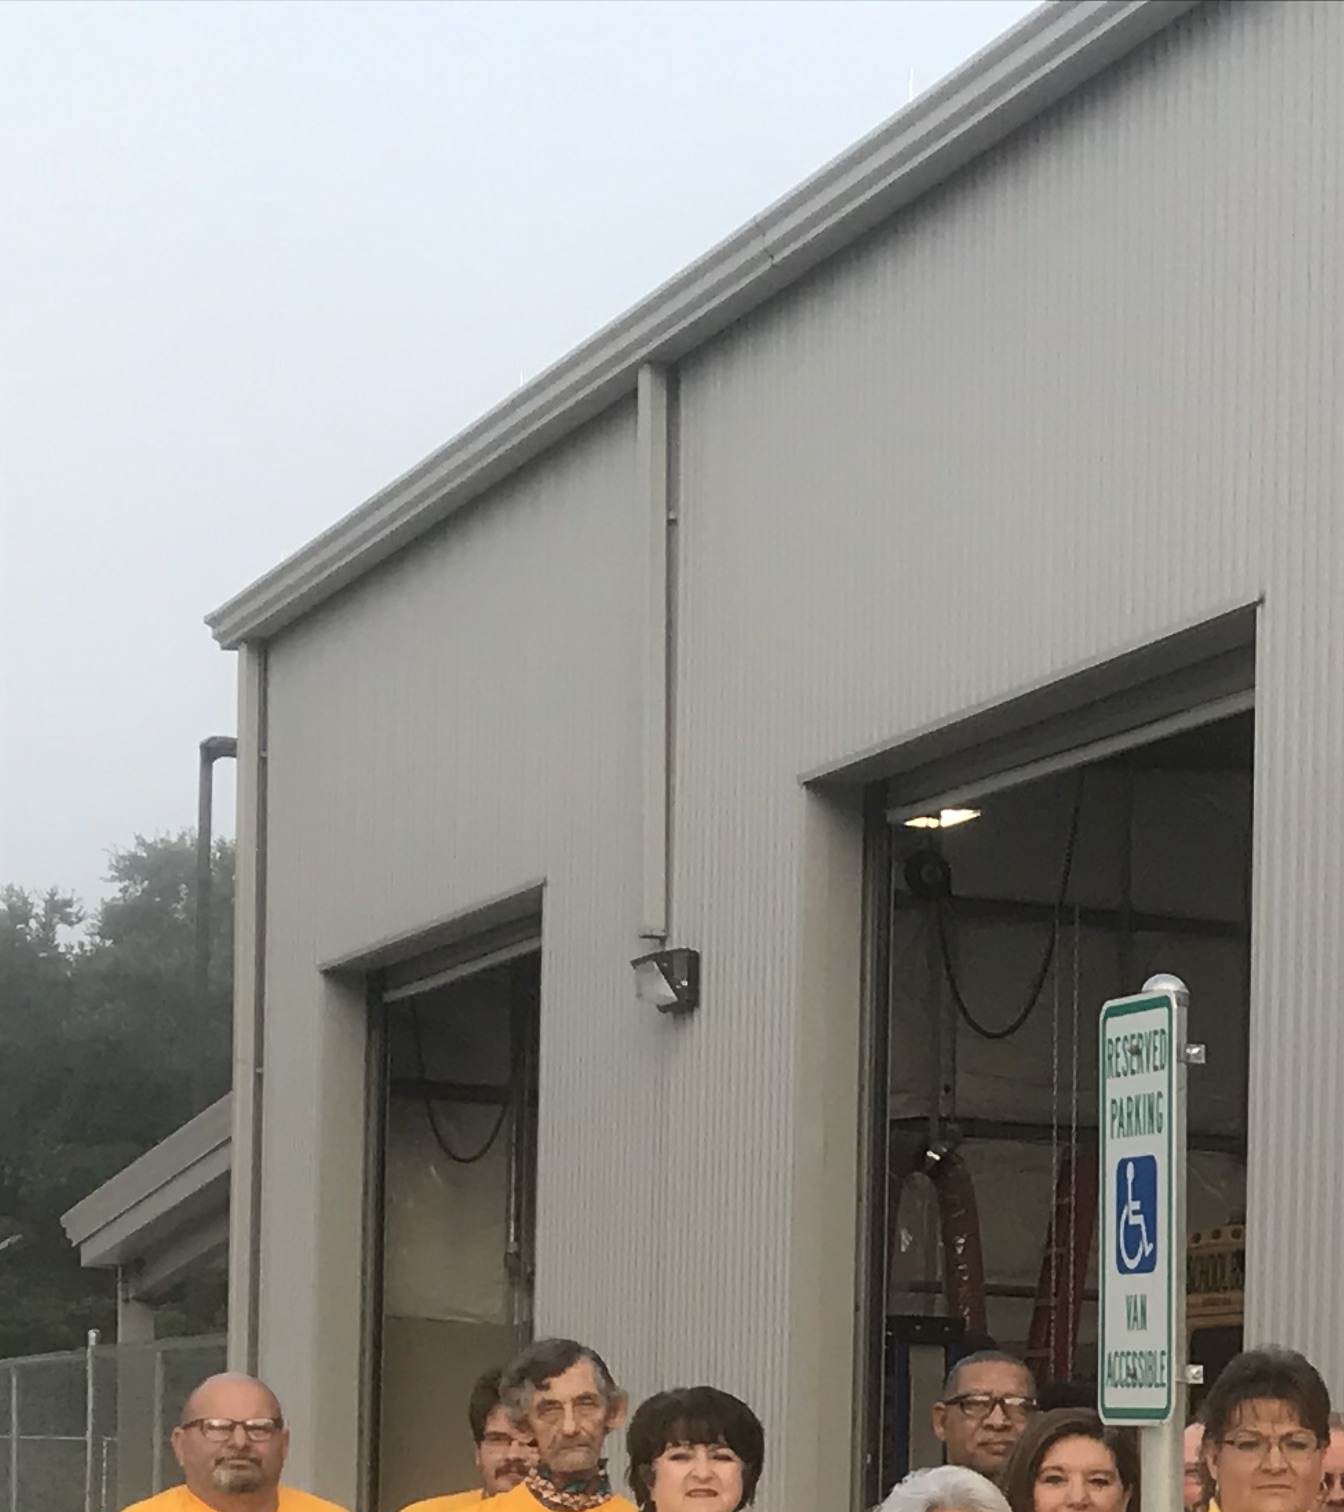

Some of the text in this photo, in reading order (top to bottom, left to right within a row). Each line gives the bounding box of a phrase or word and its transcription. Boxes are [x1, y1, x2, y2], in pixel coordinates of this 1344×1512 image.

[1107, 1029, 1167, 1079] RESERVED
[1111, 1091, 1163, 1140] PARKING
[1125, 1293, 1147, 1331] VAN
[1107, 1350, 1167, 1388] ACCESSIBLE
